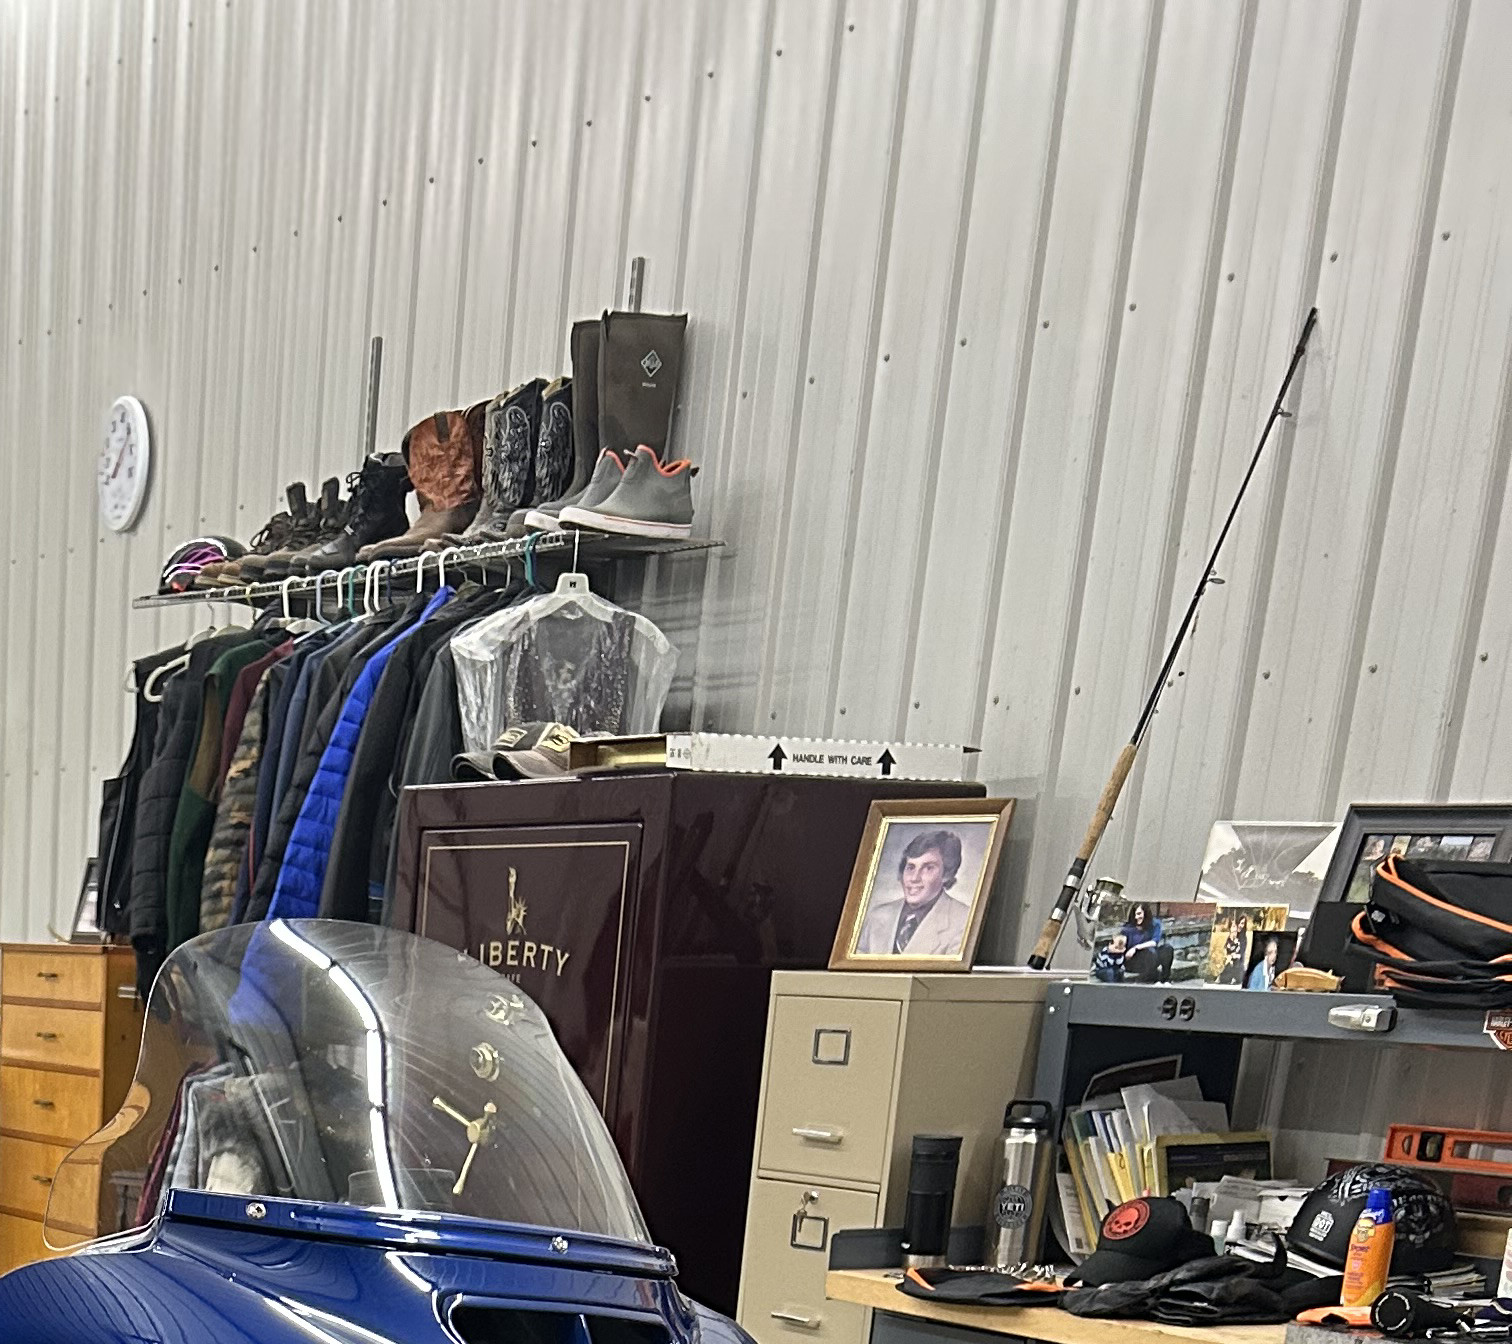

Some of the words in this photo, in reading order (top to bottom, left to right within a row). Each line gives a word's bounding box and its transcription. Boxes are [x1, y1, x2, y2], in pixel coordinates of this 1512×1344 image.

[792, 753, 825, 764] HANDLE
[828, 754, 848, 765] WITH
[851, 756, 873, 766] CARE
[464, 940, 570, 977] IBERTY
[1001, 1202, 1026, 1212] YETI
